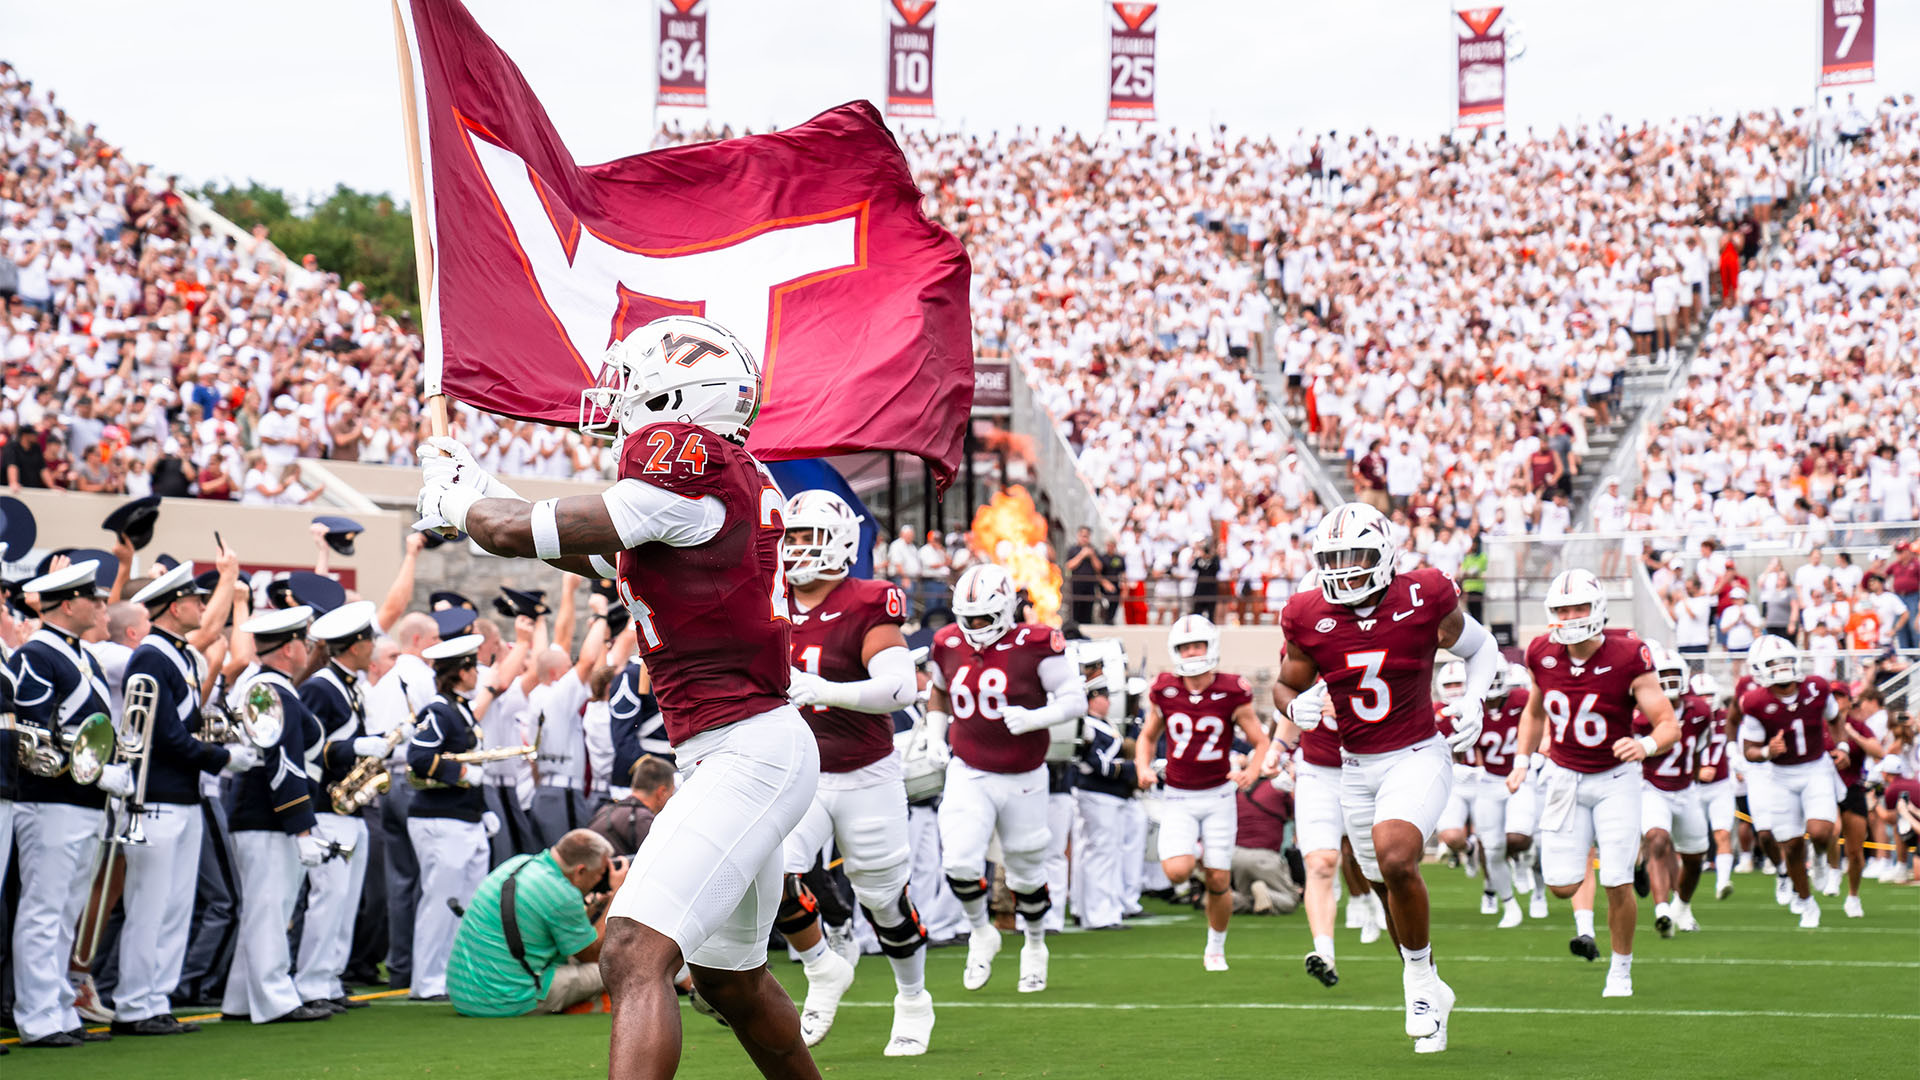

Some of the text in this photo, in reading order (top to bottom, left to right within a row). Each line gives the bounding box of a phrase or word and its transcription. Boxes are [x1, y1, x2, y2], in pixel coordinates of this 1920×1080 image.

[1835, 15, 1863, 59] 7
[661, 39, 705, 82] 84
[895, 52, 929, 93] 10
[1111, 55, 1154, 97] 25
[661, 332, 729, 368] VT
[643, 430, 708, 475] 24
[1409, 583, 1424, 607] C
[1357, 619, 1377, 631] VT
[949, 664, 1008, 720] 68
[1345, 649, 1392, 723] 3
[1167, 712, 1224, 761] 92
[1543, 689, 1609, 747] 96
[1790, 718, 1807, 756] 1
